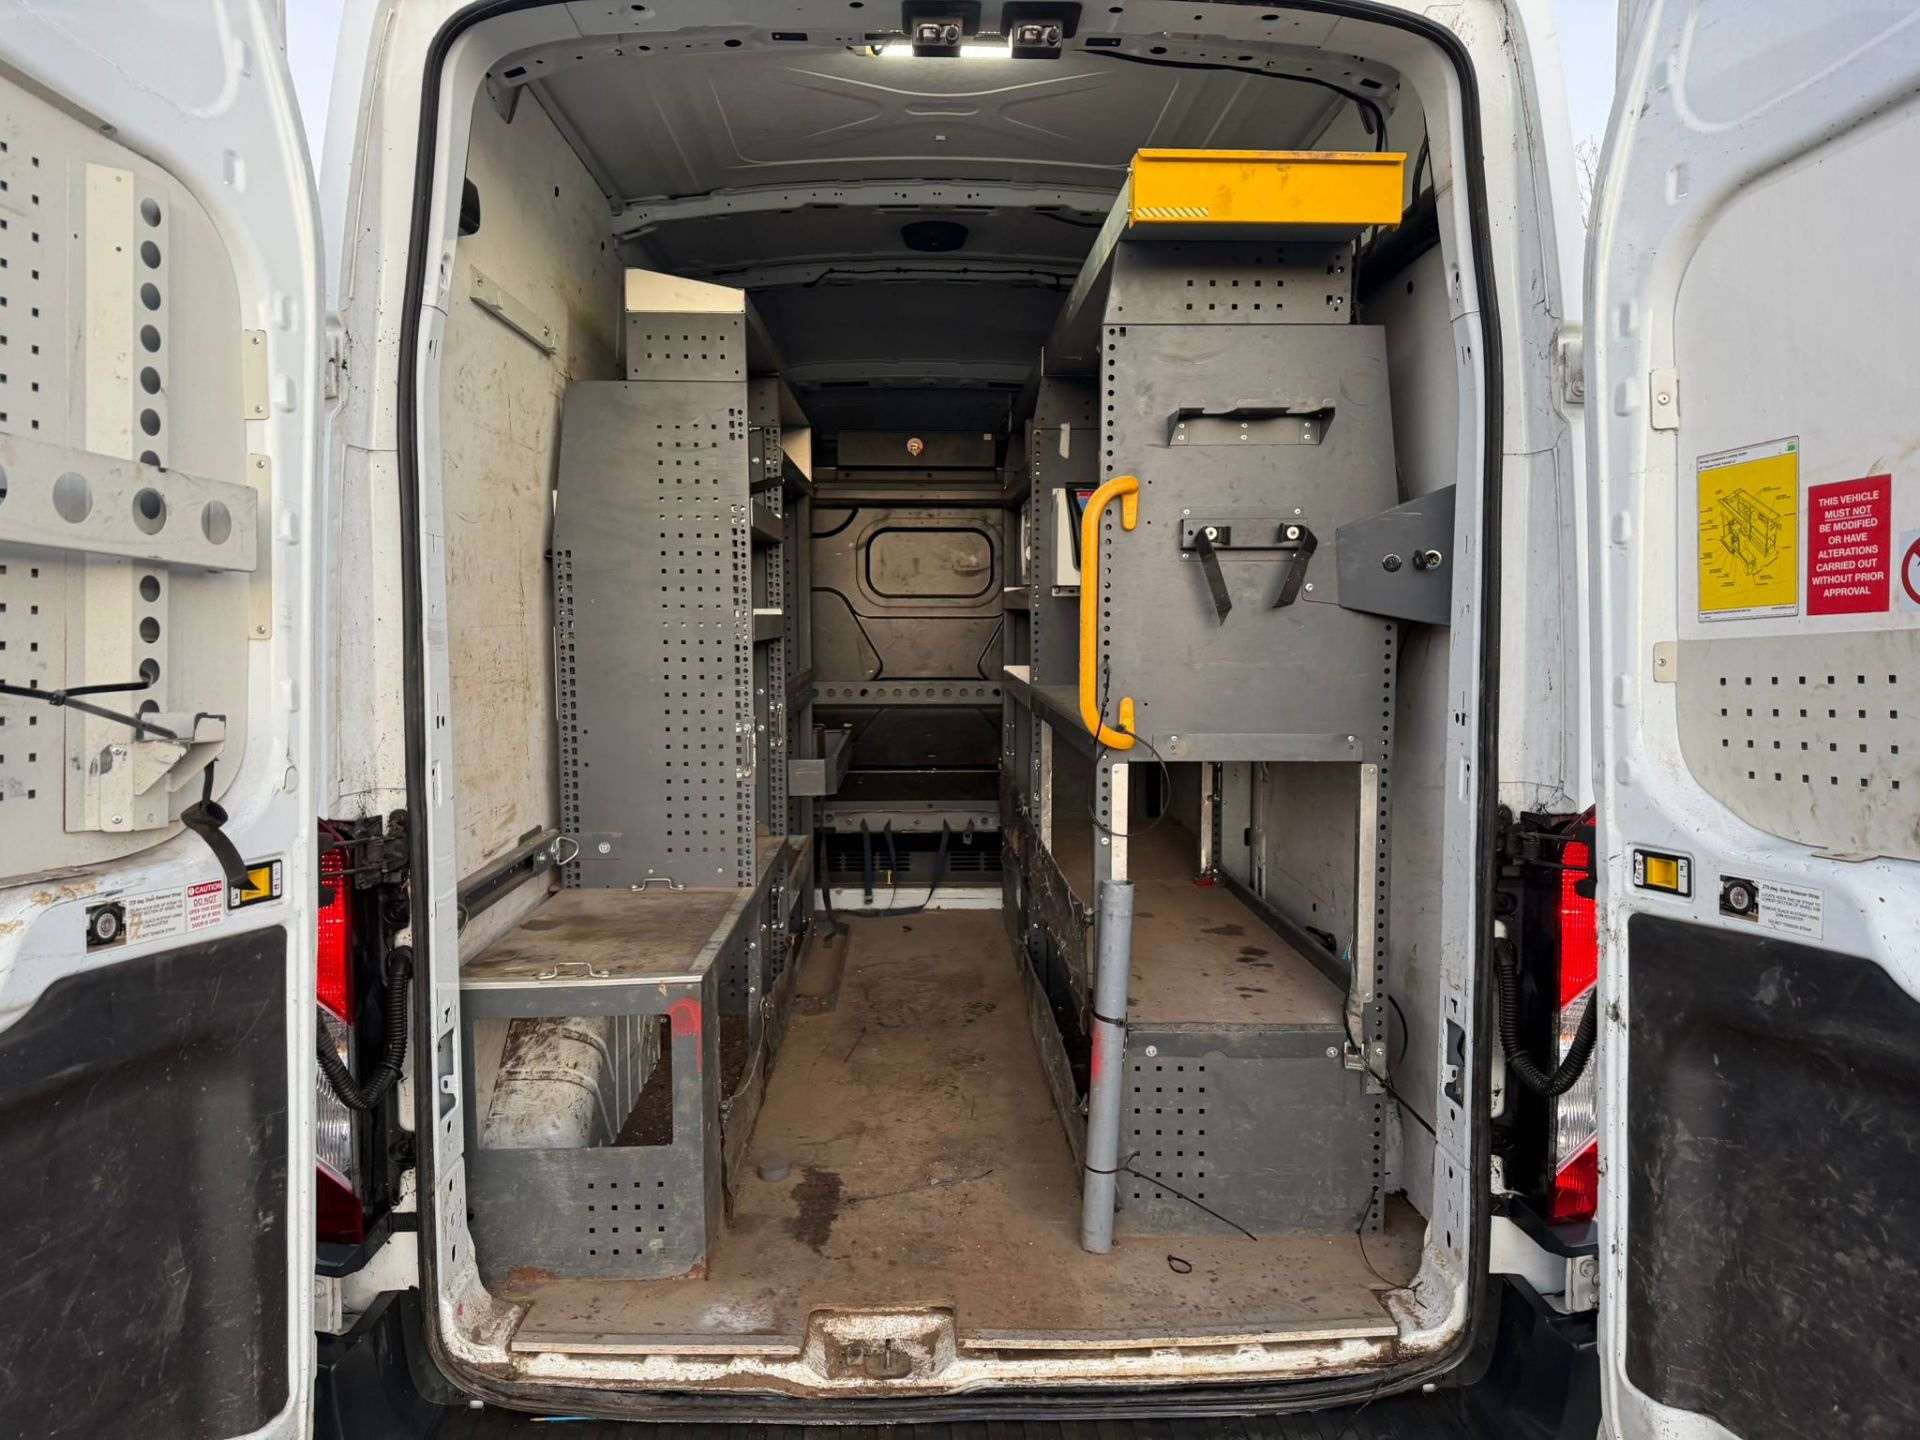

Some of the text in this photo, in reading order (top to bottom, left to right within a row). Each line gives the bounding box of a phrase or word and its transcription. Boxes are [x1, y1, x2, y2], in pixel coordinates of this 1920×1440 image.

[1818, 490, 1880, 508] THIS VEHICLE
[1825, 505, 1872, 519] MUST NOT
[1819, 518, 1878, 533] BE MODIFIED
[1828, 532, 1868, 545] OR HAVE
[1818, 545, 1878, 559] ALTERATIONS
[1816, 558, 1878, 572] CARRIED OUT
[1812, 571, 1884, 585] WITHOUT PRIOR
[1823, 586, 1871, 597] APPROVAL
[194, 883, 222, 894] CAUTION
